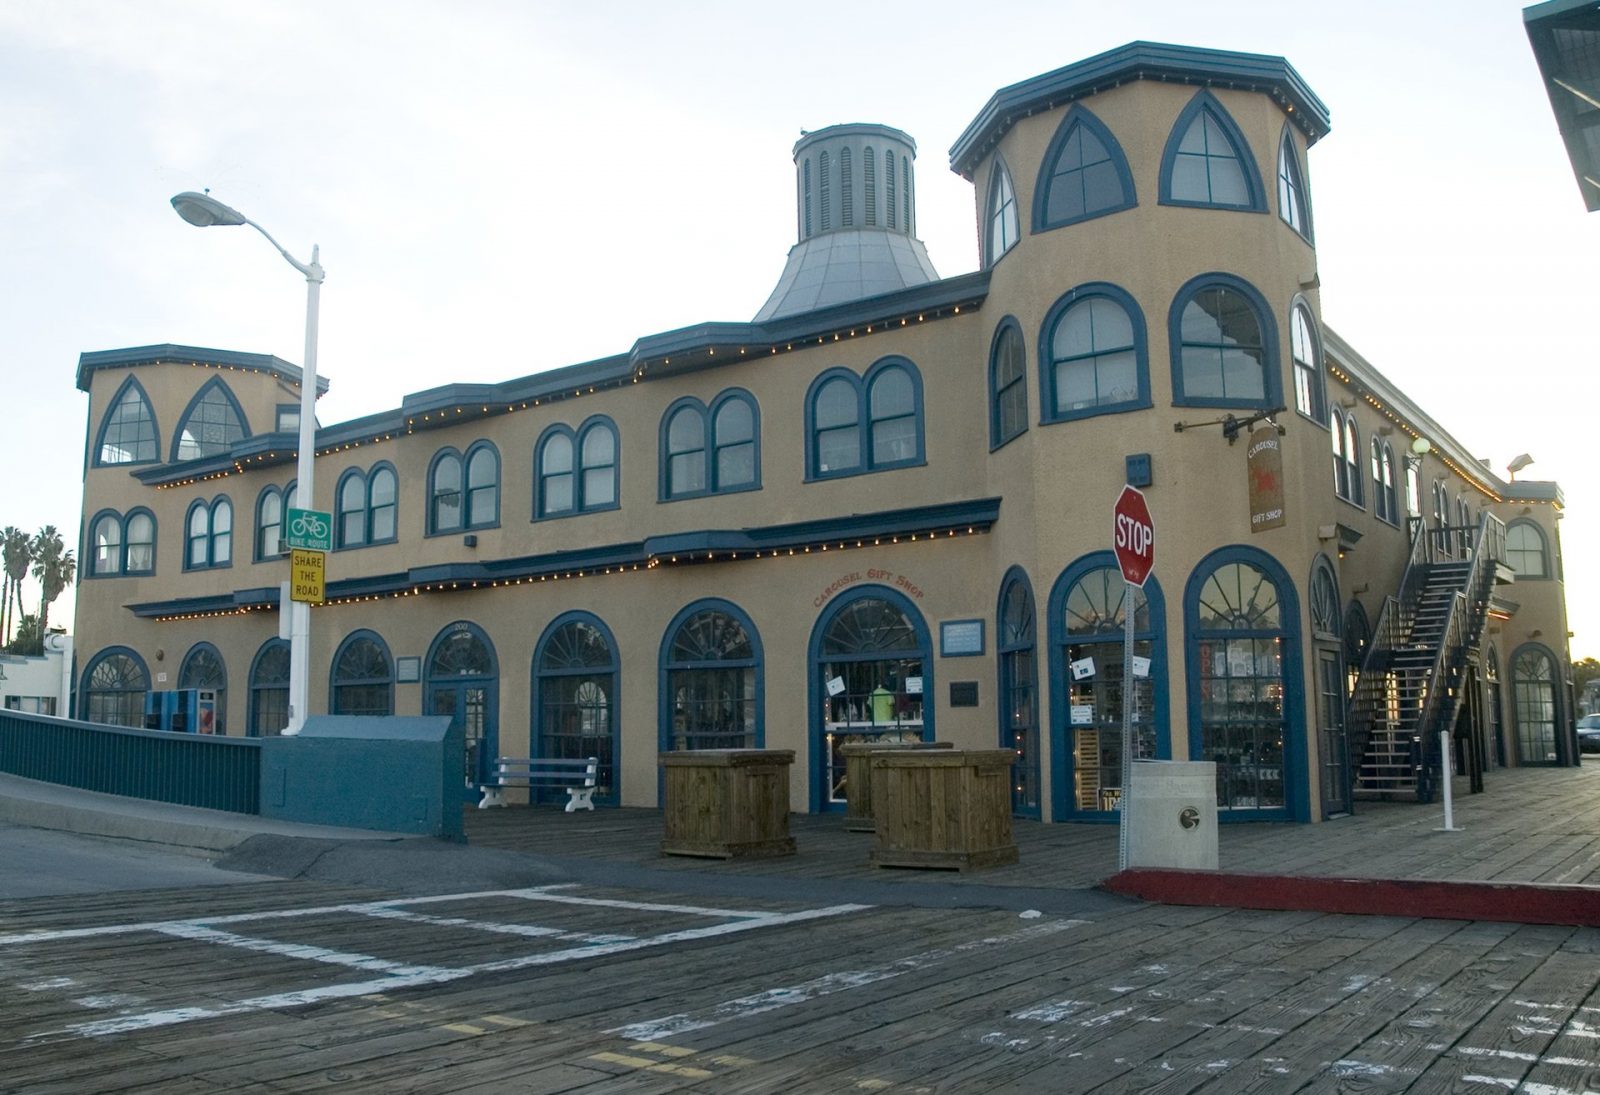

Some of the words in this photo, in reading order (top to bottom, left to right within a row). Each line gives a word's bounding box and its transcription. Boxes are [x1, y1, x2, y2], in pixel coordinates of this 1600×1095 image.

[1248, 440, 1278, 459] CAROUSEL
[1252, 512, 1265, 525] GIFT
[1266, 509, 1282, 521] SHOP
[290, 537, 305, 547] BIKE
[307, 539, 329, 549] ROUTE
[1116, 513, 1152, 558] STOP
[294, 555, 322, 569] SHARE
[300, 570, 317, 582] THE
[295, 585, 319, 597] ROAD
[814, 571, 863, 608] CAROUSEL
[867, 568, 894, 581] GIFT
[895, 575, 924, 600] SHOP
